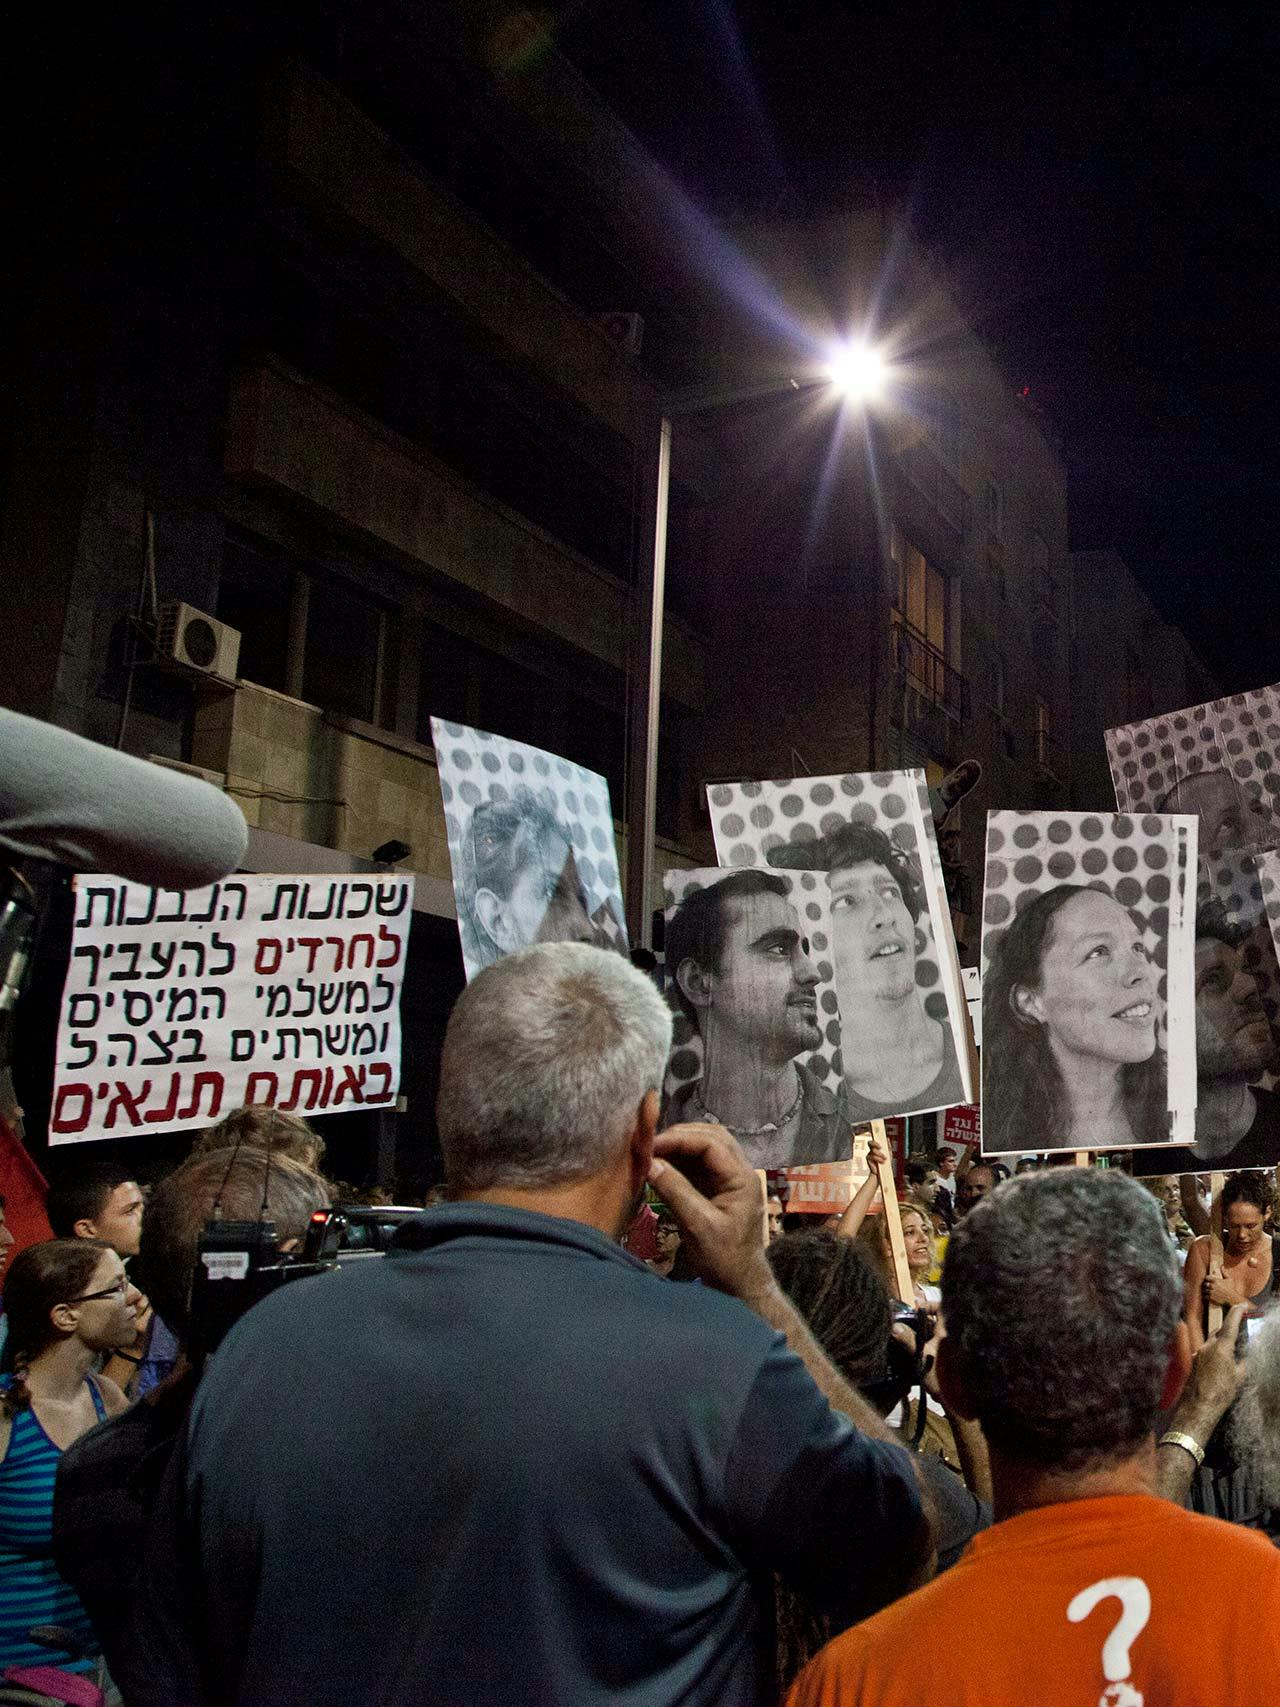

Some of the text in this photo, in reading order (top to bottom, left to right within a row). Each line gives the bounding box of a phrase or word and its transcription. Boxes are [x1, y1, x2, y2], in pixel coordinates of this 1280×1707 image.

[76, 883, 408, 928] שכונות הנבנות
[74, 924, 401, 987] לחרדים להעביר
[68, 973, 394, 1029] למשלמי המיסים
[66, 1022, 390, 1069] ומשרתים בצהל
[52, 1062, 394, 1133] באותם תנאים
[945, 1127, 981, 1142] משלה
